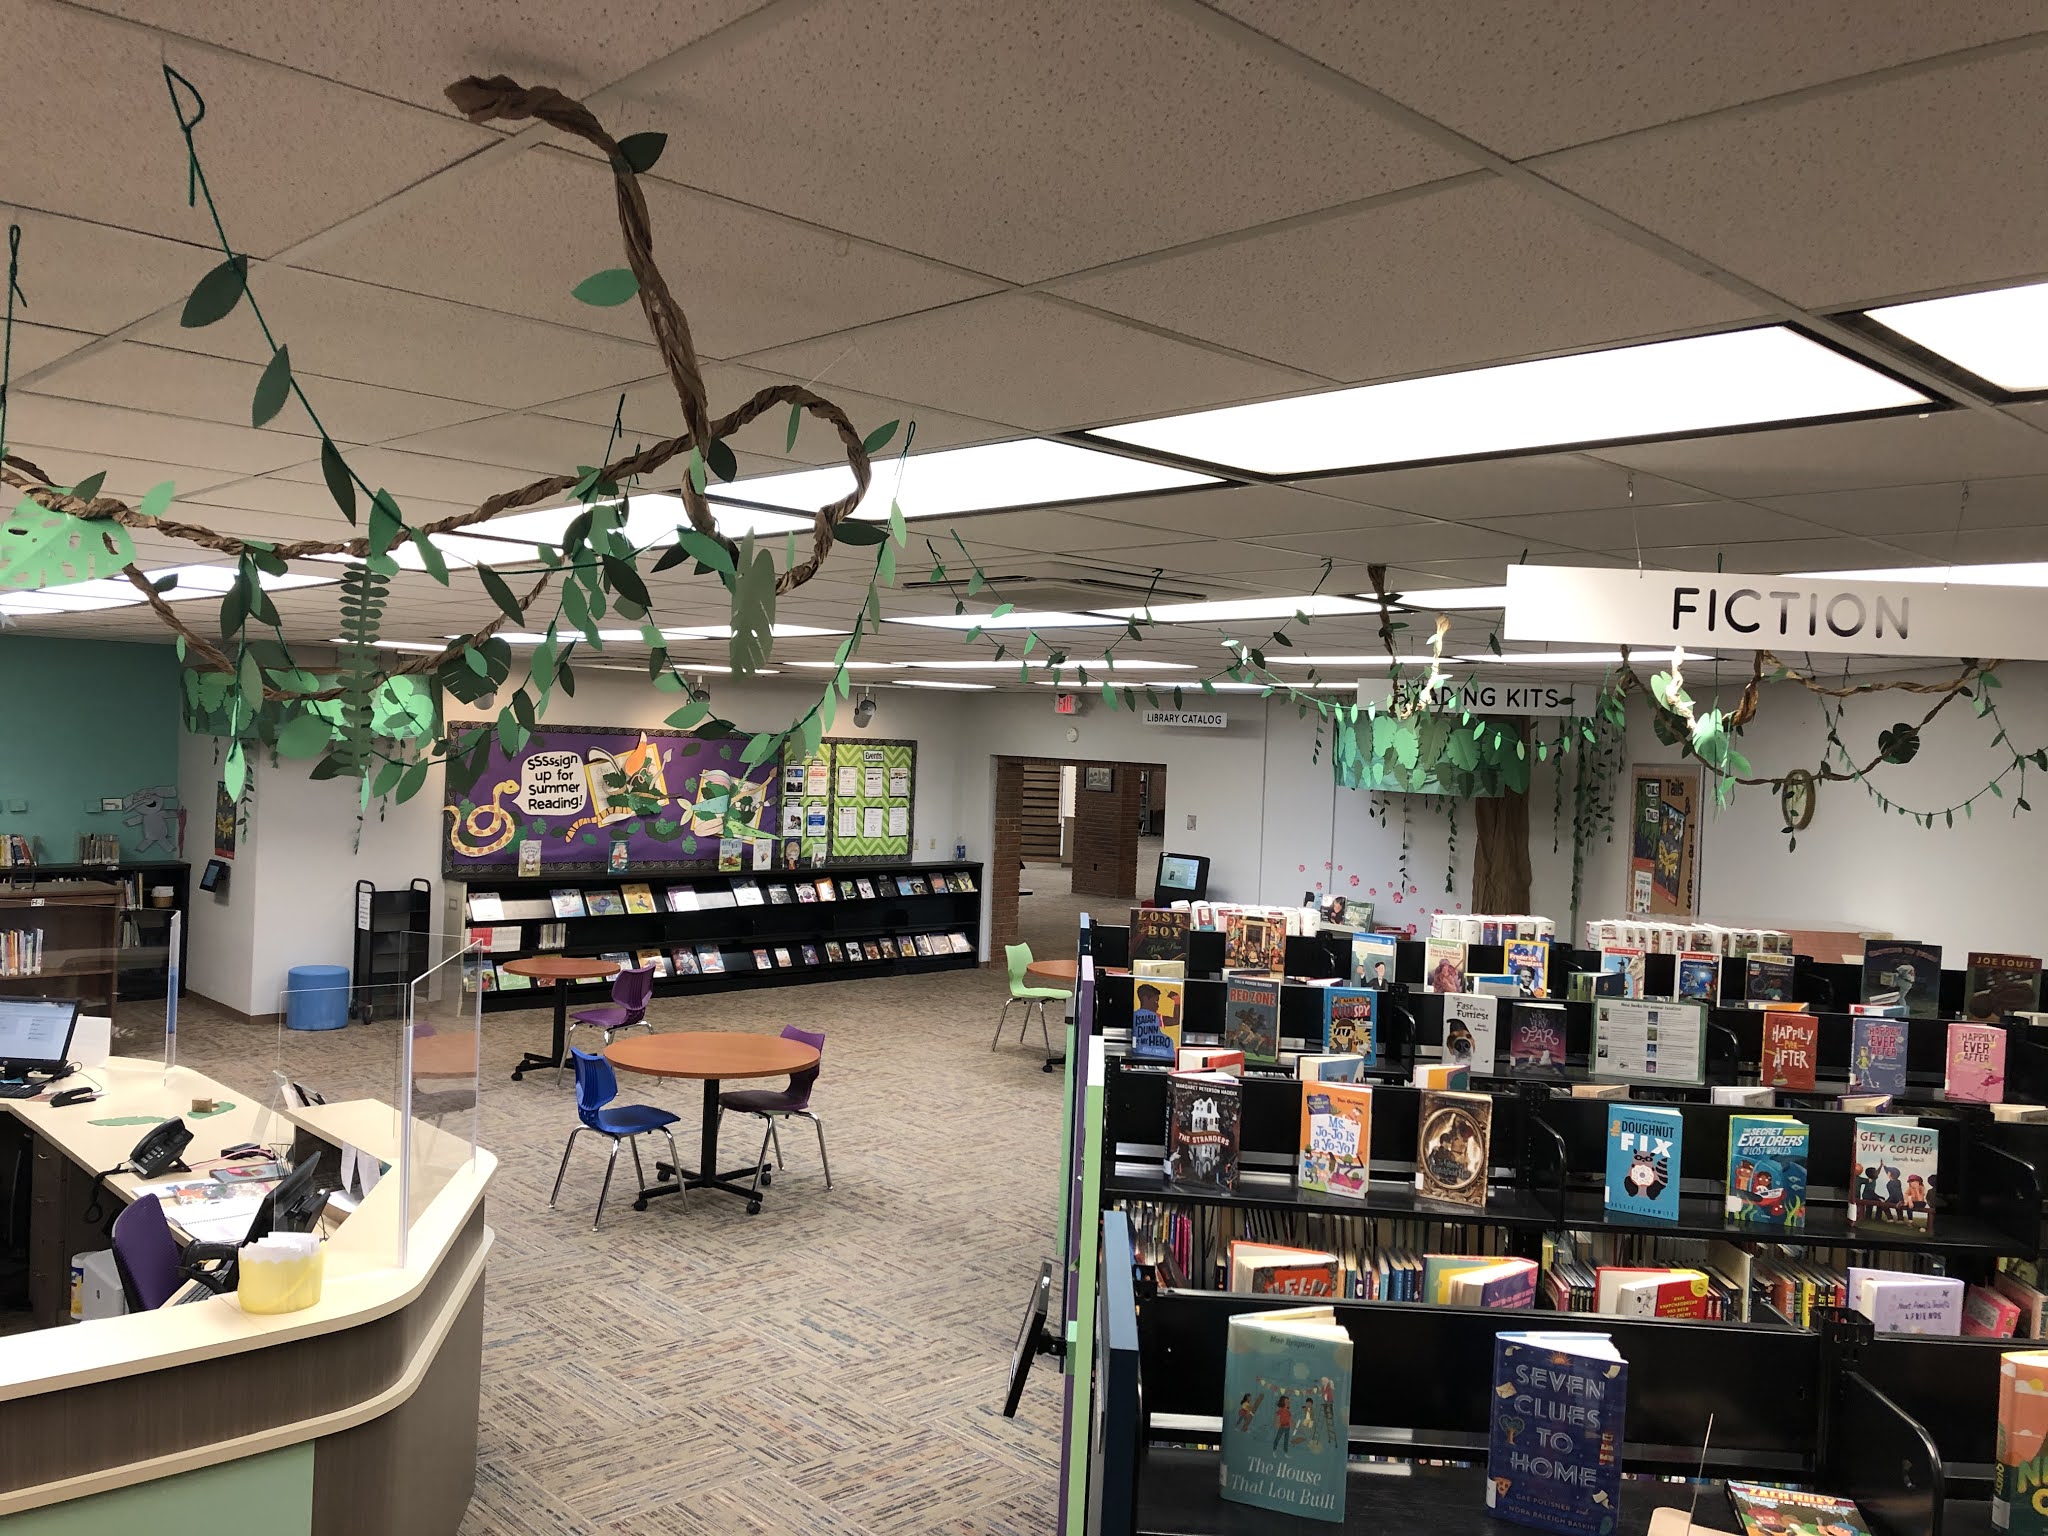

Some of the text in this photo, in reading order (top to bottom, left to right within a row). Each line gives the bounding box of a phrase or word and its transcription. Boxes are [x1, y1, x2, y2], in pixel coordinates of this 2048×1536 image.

[1672, 587, 1910, 640] FICTION
[1506, 688, 1559, 708] KITS
[1147, 713, 1222, 724] LIBRARY CATALOG
[864, 751, 883, 760] Events
[535, 769, 574, 783] up for
[528, 783, 580, 795] Summer
[528, 795, 583, 810] Reading!
[1138, 911, 1184, 924] LOST
[1148, 926, 1182, 939] BOY
[1976, 956, 2036, 969] JOE LOUIS
[1230, 988, 1276, 1007] RED ZONE
[1354, 1004, 1370, 1018] SPY
[1456, 1002, 1473, 1011] Fast
[1135, 1014, 1156, 1027] ISAIAH
[1456, 1010, 1489, 1020] Furriest
[1137, 1025, 1158, 1037] DUNN
[1521, 1027, 1559, 1044] FAR
[1772, 1024, 1813, 1045] HAPPILY
[1869, 1026, 1902, 1036] HAPPILY
[1961, 1032, 1996, 1043] HAPPILY
[1148, 1035, 1170, 1048] HERO
[1871, 1036, 1896, 1047] EVER
[1964, 1042, 1990, 1053] EVER
[1871, 1046, 1897, 1056] AFTER
[1772, 1048, 1809, 1069] AFTER
[1963, 1053, 1989, 1063] AFTER
[1328, 1116, 1346, 1129] Ms.
[1316, 1126, 1343, 1140] Jo-Jo
[1622, 1121, 1674, 1138] DOUGHNUT
[1750, 1128, 1783, 1136] SECRET
[1178, 1132, 1190, 1143] THE
[1738, 1134, 1804, 1147] EXPLORERS
[1860, 1132, 1933, 1146] GET A GRIP,
[1314, 1140, 1320, 1149] a
[1620, 1133, 1673, 1158] FIX
[1862, 1144, 1933, 1155] VIVY COHEN!
[1786, 1292, 1794, 1314] JETER
[1911, 1312, 1941, 1320] FRIENDS
[1515, 1364, 1605, 1400] SEVEN
[1513, 1395, 1600, 1428] CLUES
[1536, 1427, 1573, 1454] TO
[1247, 1456, 1322, 1486] The House
[1510, 1452, 1597, 1488] HOME
[1232, 1474, 1336, 1510] That Lou Built
[1750, 1488, 1839, 1505] ZACH RILEY
[1516, 1493, 1531, 1502] GAE
[1533, 1496, 1571, 1511] POLISNER
[1508, 1505, 1596, 1531] NORA RALEIGH BASKIN
